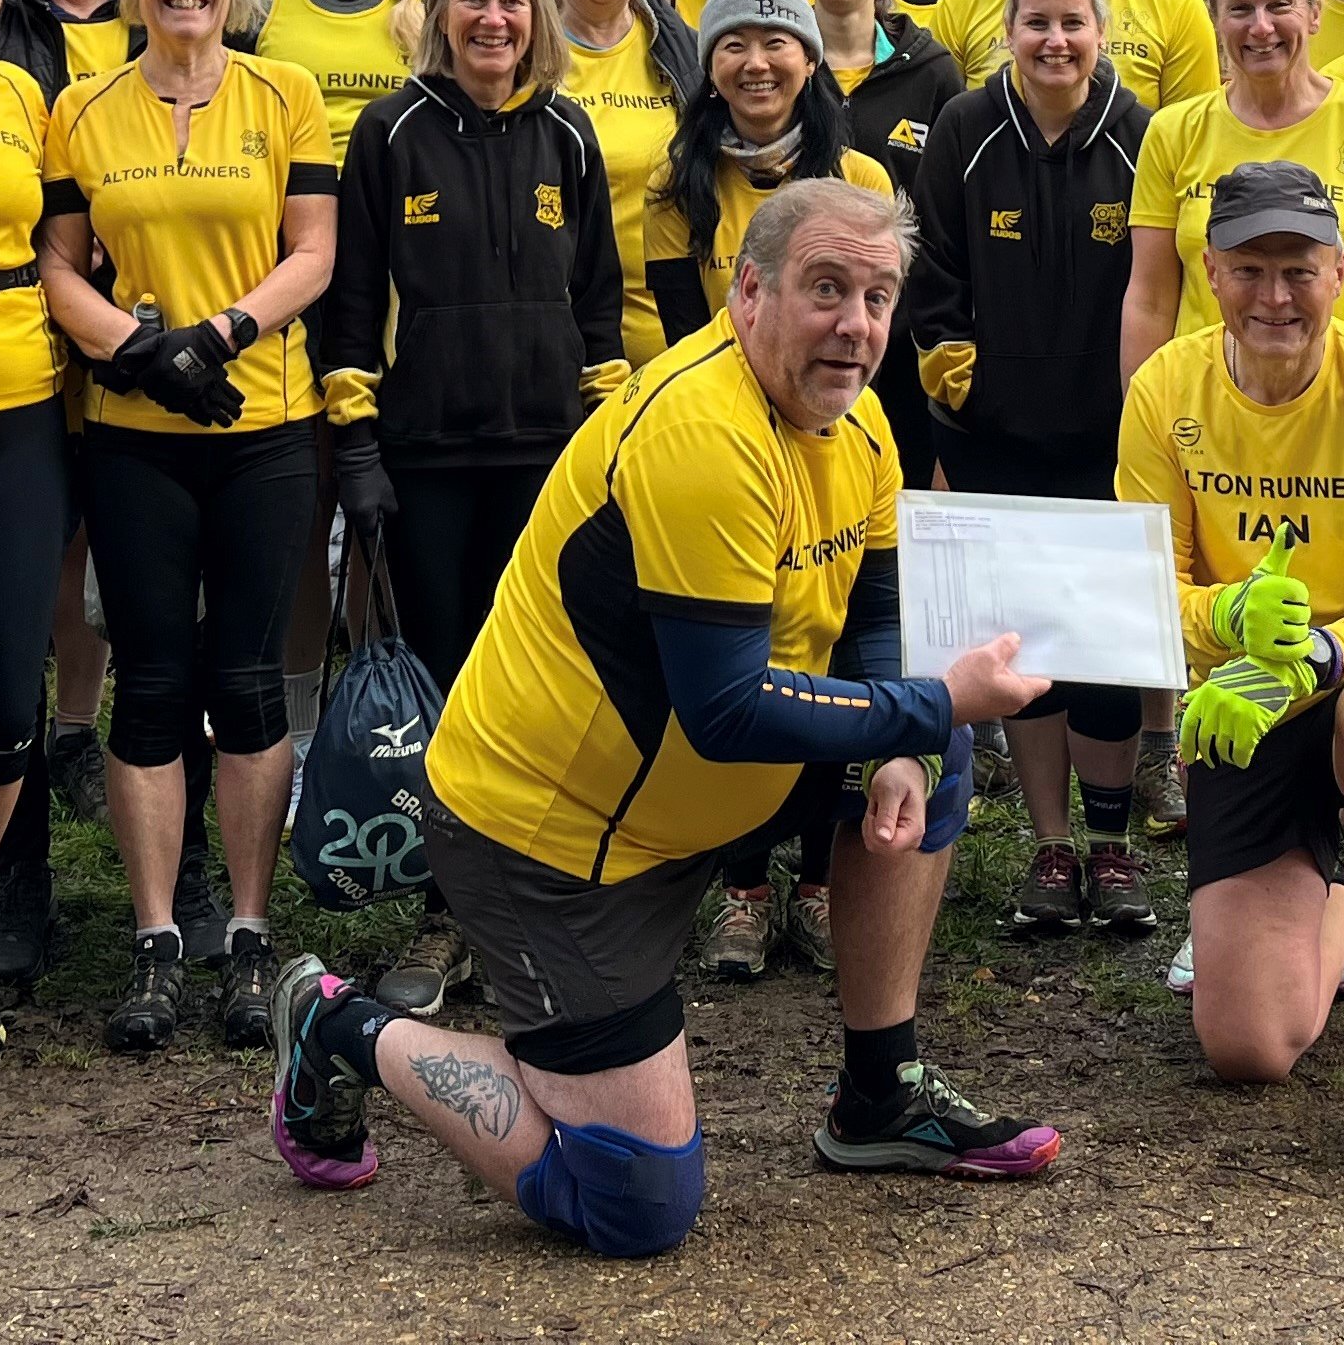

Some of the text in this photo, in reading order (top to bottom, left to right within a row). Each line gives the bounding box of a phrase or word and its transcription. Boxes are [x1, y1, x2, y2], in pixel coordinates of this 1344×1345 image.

[102, 165, 251, 186] ALTON RUNNERS
[1184, 469, 1253, 497] LTON
[1238, 511, 1311, 544] IAN
[328, 867, 368, 900] 2003
